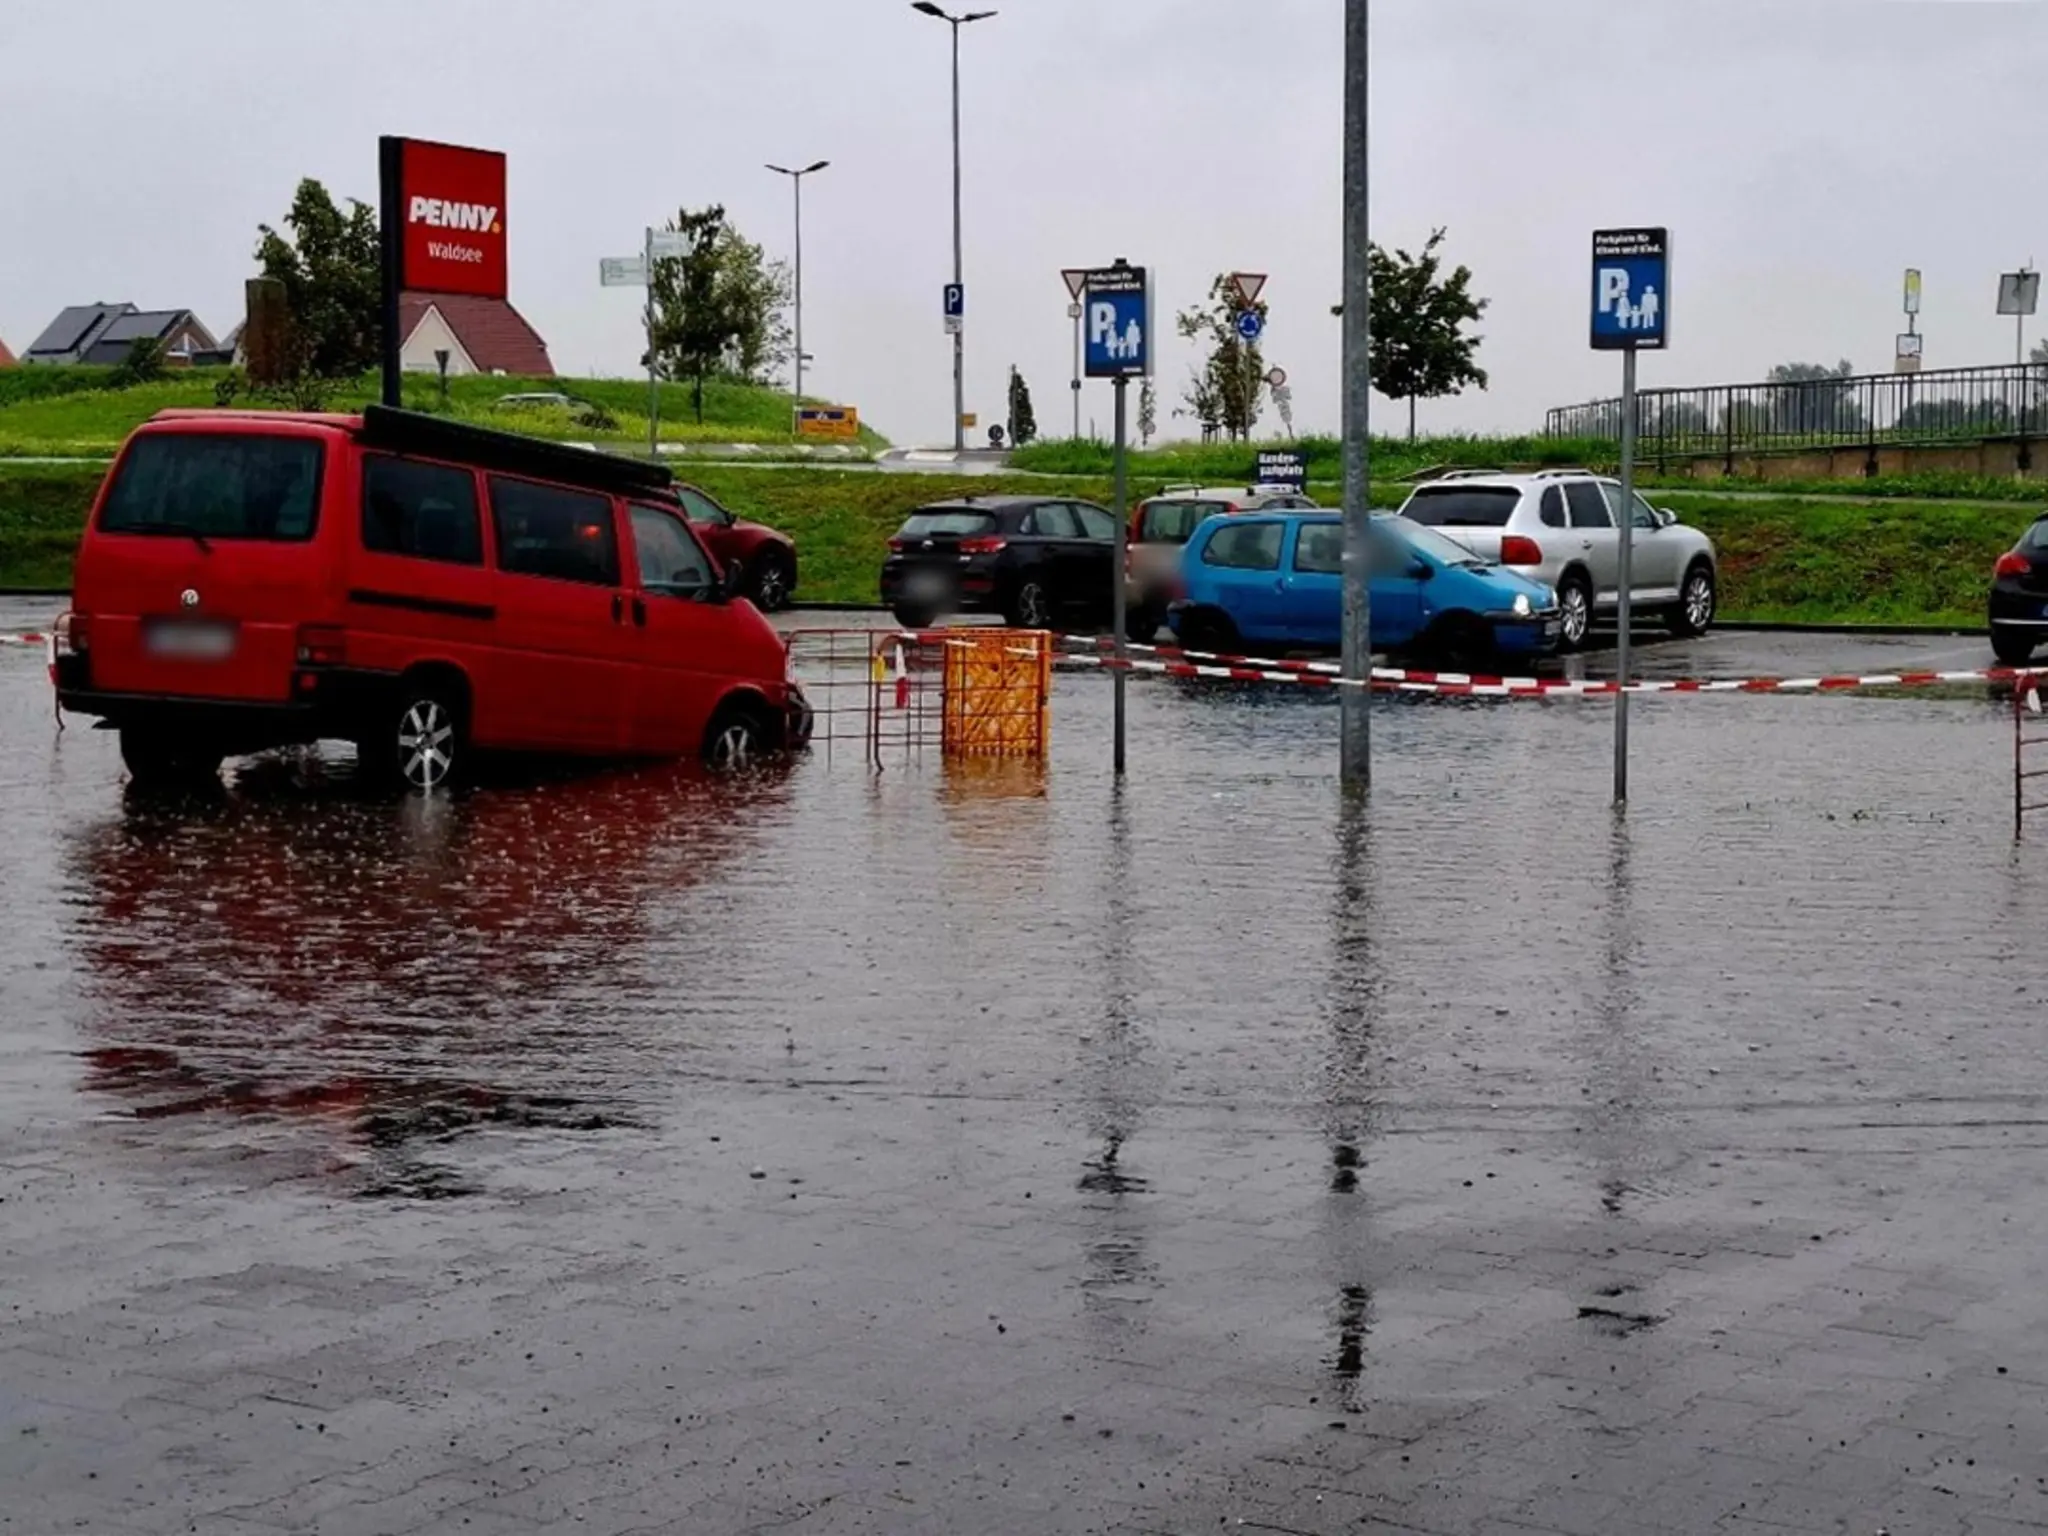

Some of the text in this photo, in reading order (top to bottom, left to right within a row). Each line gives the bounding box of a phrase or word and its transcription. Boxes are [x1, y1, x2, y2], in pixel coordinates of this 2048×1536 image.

[427, 241, 483, 263] Waldsee
[948, 287, 960, 312] P
[1599, 268, 1630, 313] P
[1091, 302, 1117, 344] P
